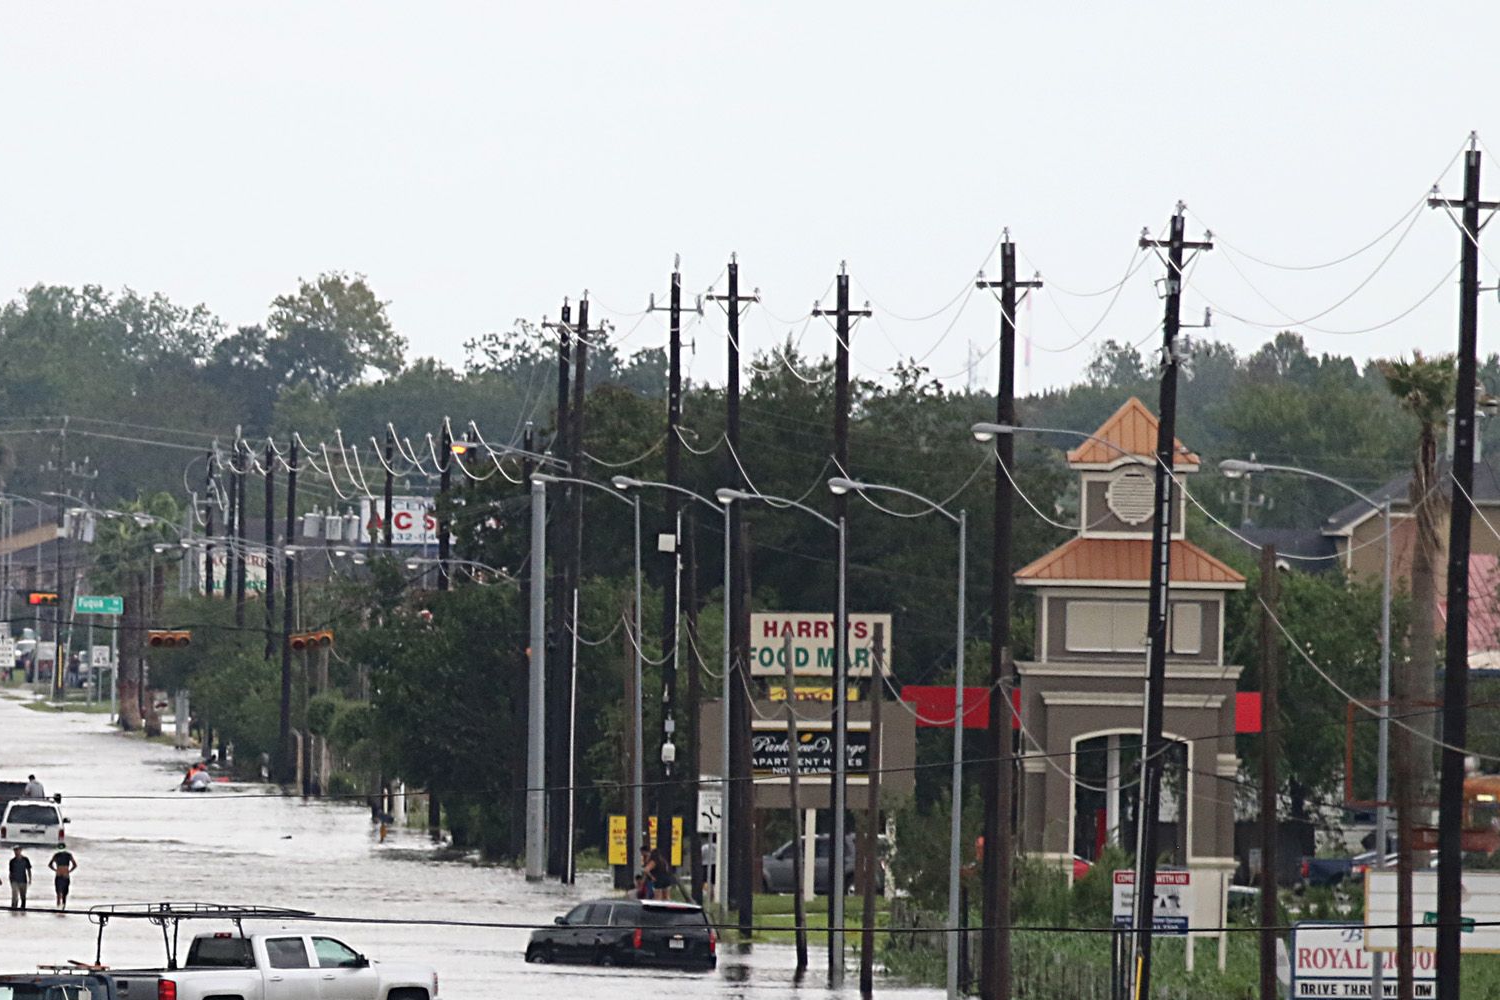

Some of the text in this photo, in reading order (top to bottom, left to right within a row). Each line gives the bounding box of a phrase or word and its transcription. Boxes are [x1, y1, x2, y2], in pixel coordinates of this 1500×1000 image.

[763, 620, 868, 639] HARR'S
[752, 758, 863, 766] APARTENT HES
[1299, 948, 1368, 969] ROYAL
[1301, 984, 1337, 995] DRIVE
[1383, 985, 1432, 996] WIOW
